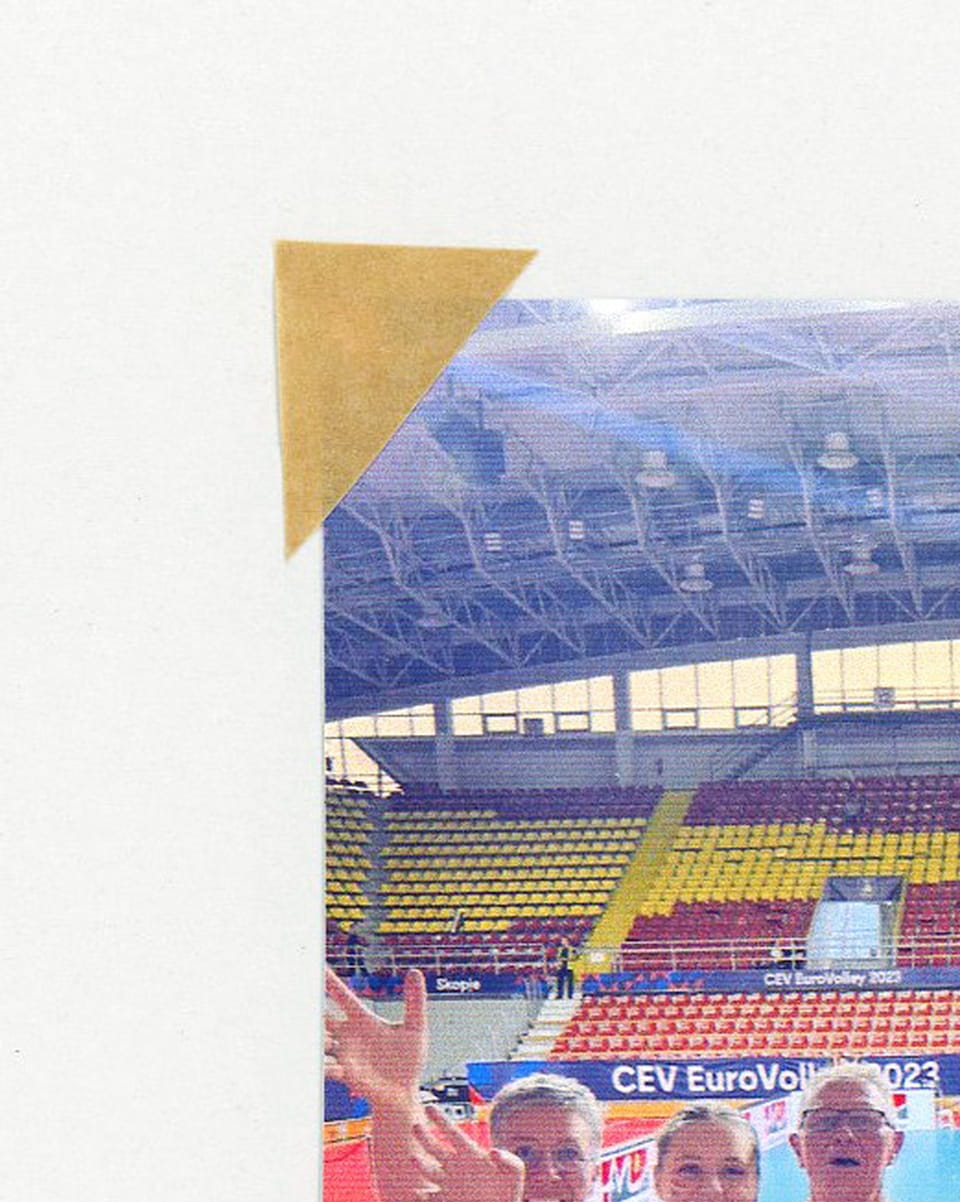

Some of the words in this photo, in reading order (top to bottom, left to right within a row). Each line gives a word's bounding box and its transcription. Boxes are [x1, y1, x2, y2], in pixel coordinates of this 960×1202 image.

[436, 977, 481, 992] Skopje
[764, 972, 792, 985] CEV
[795, 970, 866, 986] EuroVolley
[868, 970, 901, 984] 2023
[611, 1064, 678, 1093] CEV
[686, 1061, 820, 1092] EuroVoll
